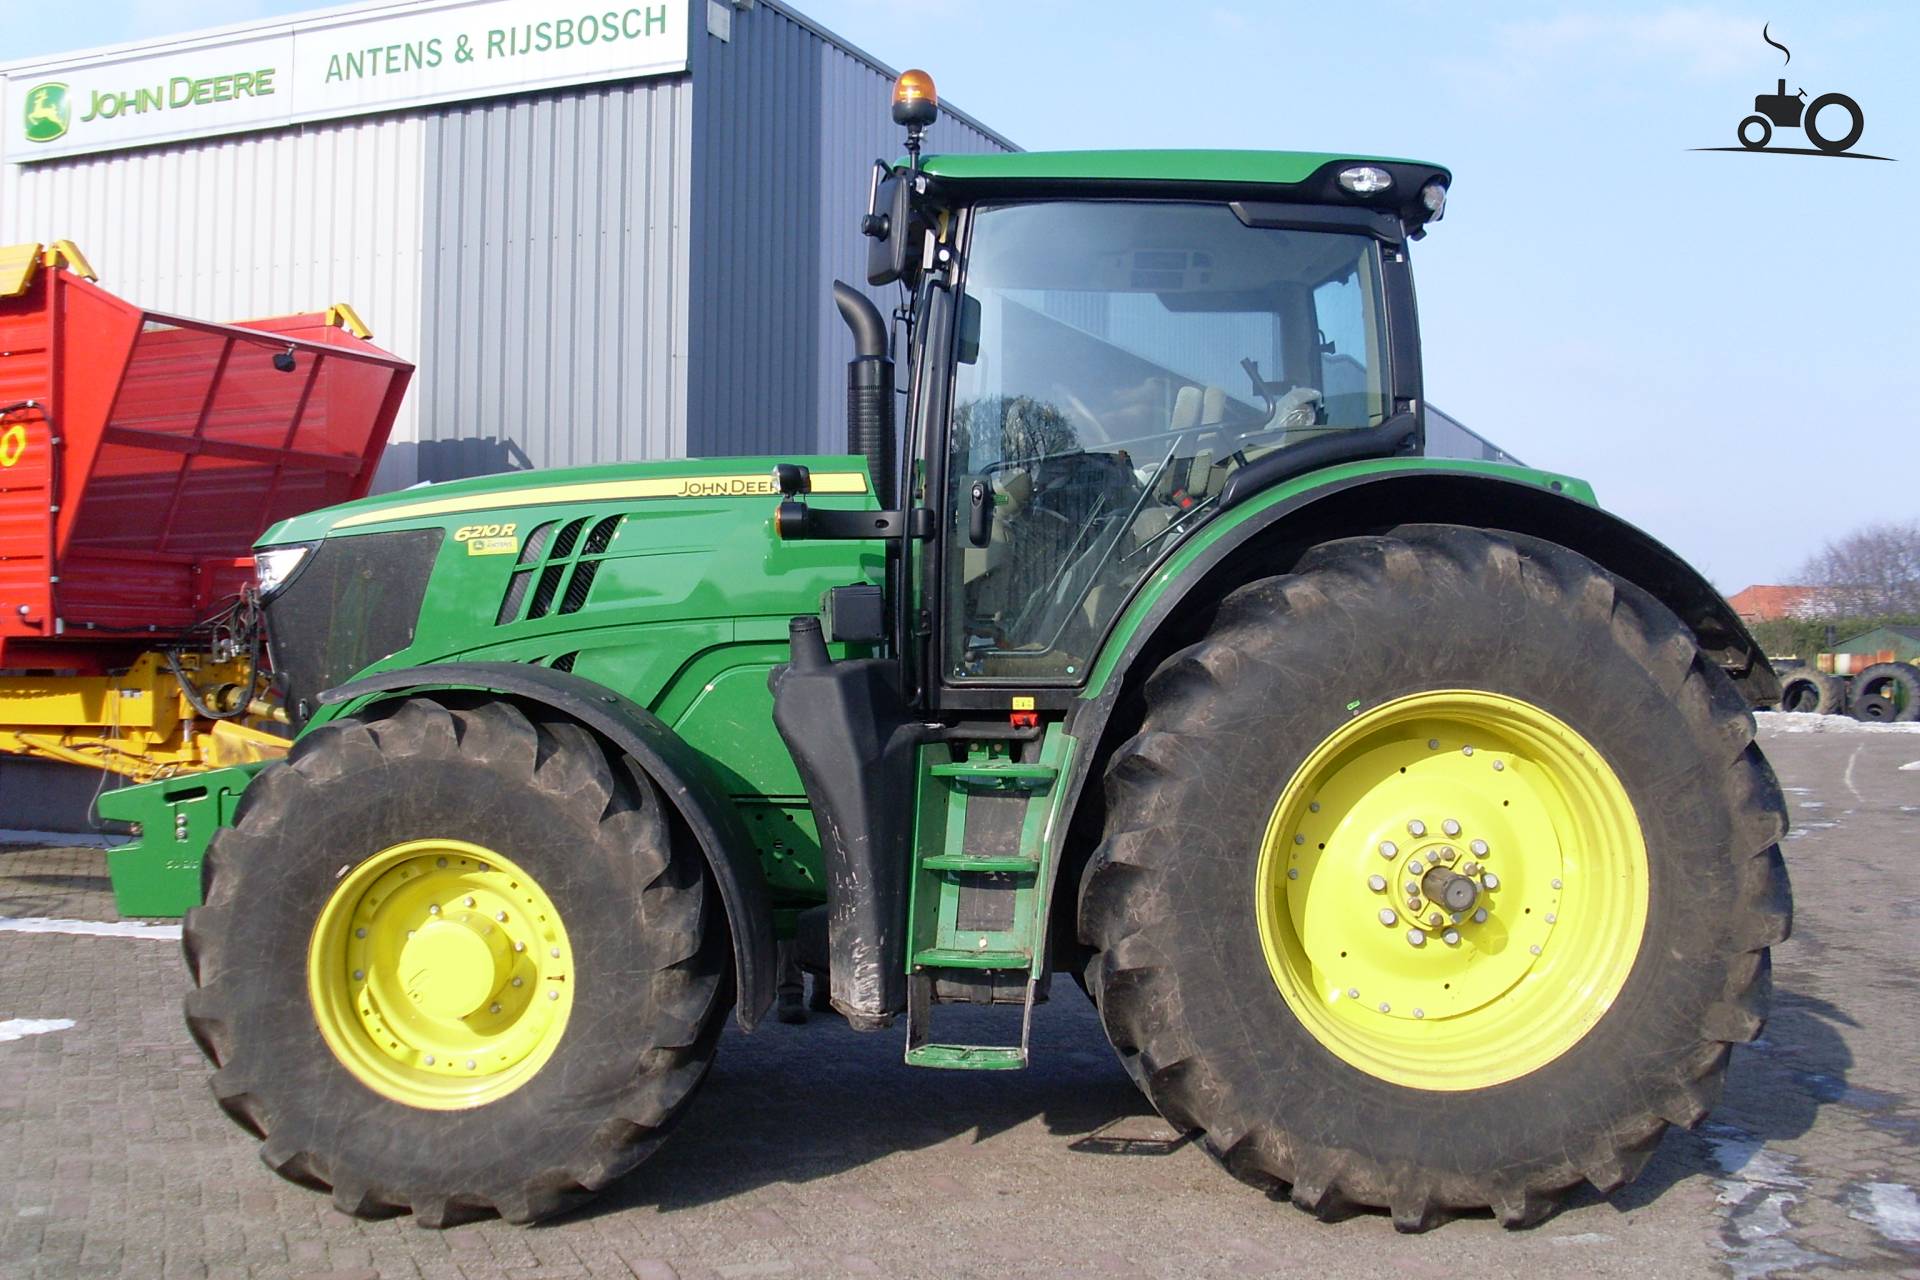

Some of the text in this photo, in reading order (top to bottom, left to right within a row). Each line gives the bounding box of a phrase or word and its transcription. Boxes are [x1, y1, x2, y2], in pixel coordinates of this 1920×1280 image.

[325, 4, 667, 83] ANTENS & RIJSBOSCH
[80, 68, 276, 122] JOHN DEERE
[678, 480, 776, 495] JOHN DEE
